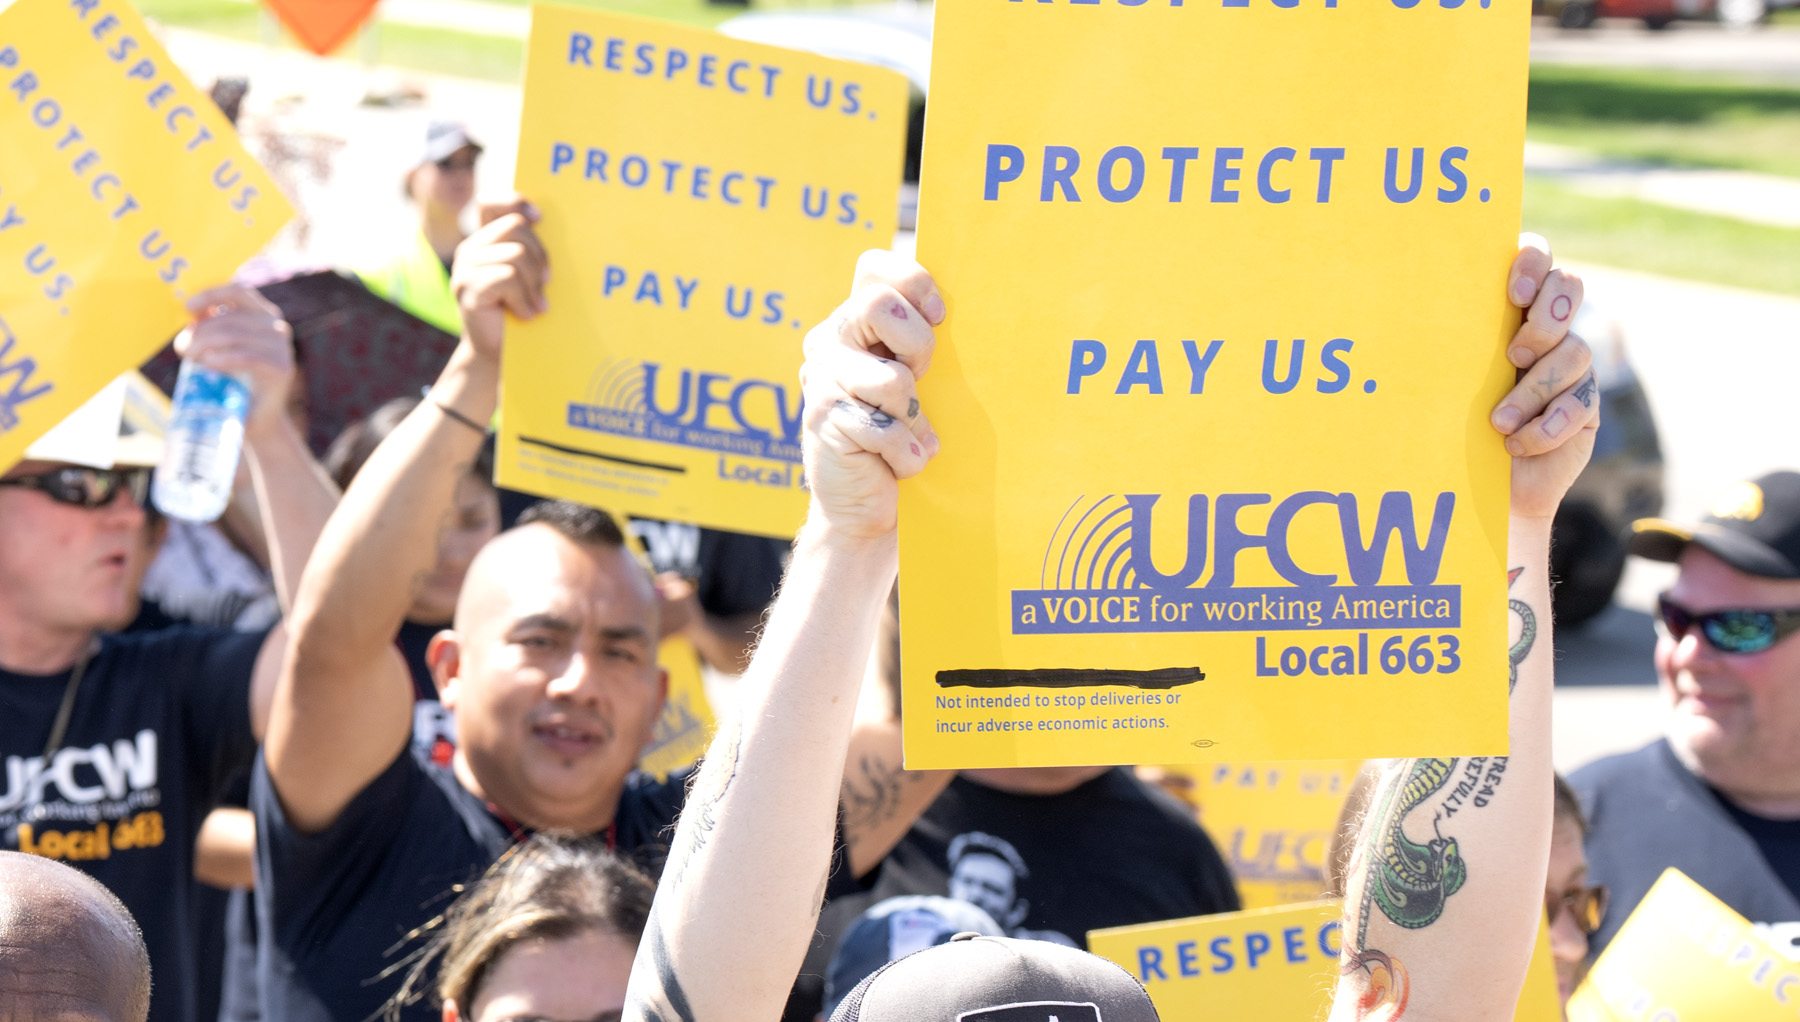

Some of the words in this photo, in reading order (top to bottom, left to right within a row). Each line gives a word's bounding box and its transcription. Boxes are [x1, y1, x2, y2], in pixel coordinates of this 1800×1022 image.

[568, 32, 782, 98] RESPECT
[807, 76, 877, 121] US.
[551, 143, 777, 210] PROTECT
[803, 187, 875, 231] US.
[983, 144, 1346, 203] PROTECT
[1383, 146, 1491, 203] US.
[603, 266, 700, 312] PAY
[726, 287, 802, 329] US.
[1066, 339, 1224, 395] PAY
[1261, 338, 1378, 395] US.
[717, 453, 792, 490] Local
[1123, 490, 1457, 589] UFCW
[1020, 602, 1038, 625] a
[1041, 597, 1141, 625] VOICE
[1149, 595, 1193, 623] for
[1202, 594, 1322, 627] working
[1331, 594, 1452, 620] America
[1255, 632, 1369, 677] Local
[1379, 634, 1462, 675] 663
[935, 695, 962, 709] Not
[966, 692, 1030, 708] intended
[1034, 693, 1050, 707] to
[1053, 692, 1086, 710] stop
[1089, 691, 1161, 706] deliveries
[1165, 691, 1182, 705] or
[935, 717, 973, 733] incur
[976, 716, 1034, 732] adverse
[1037, 716, 1108, 731] economic
[1111, 713, 1170, 730] actions.
[1474, 756, 1509, 808] TREAD
[17, 822, 111, 860] Local
[1137, 922, 1342, 983] RESPEC
